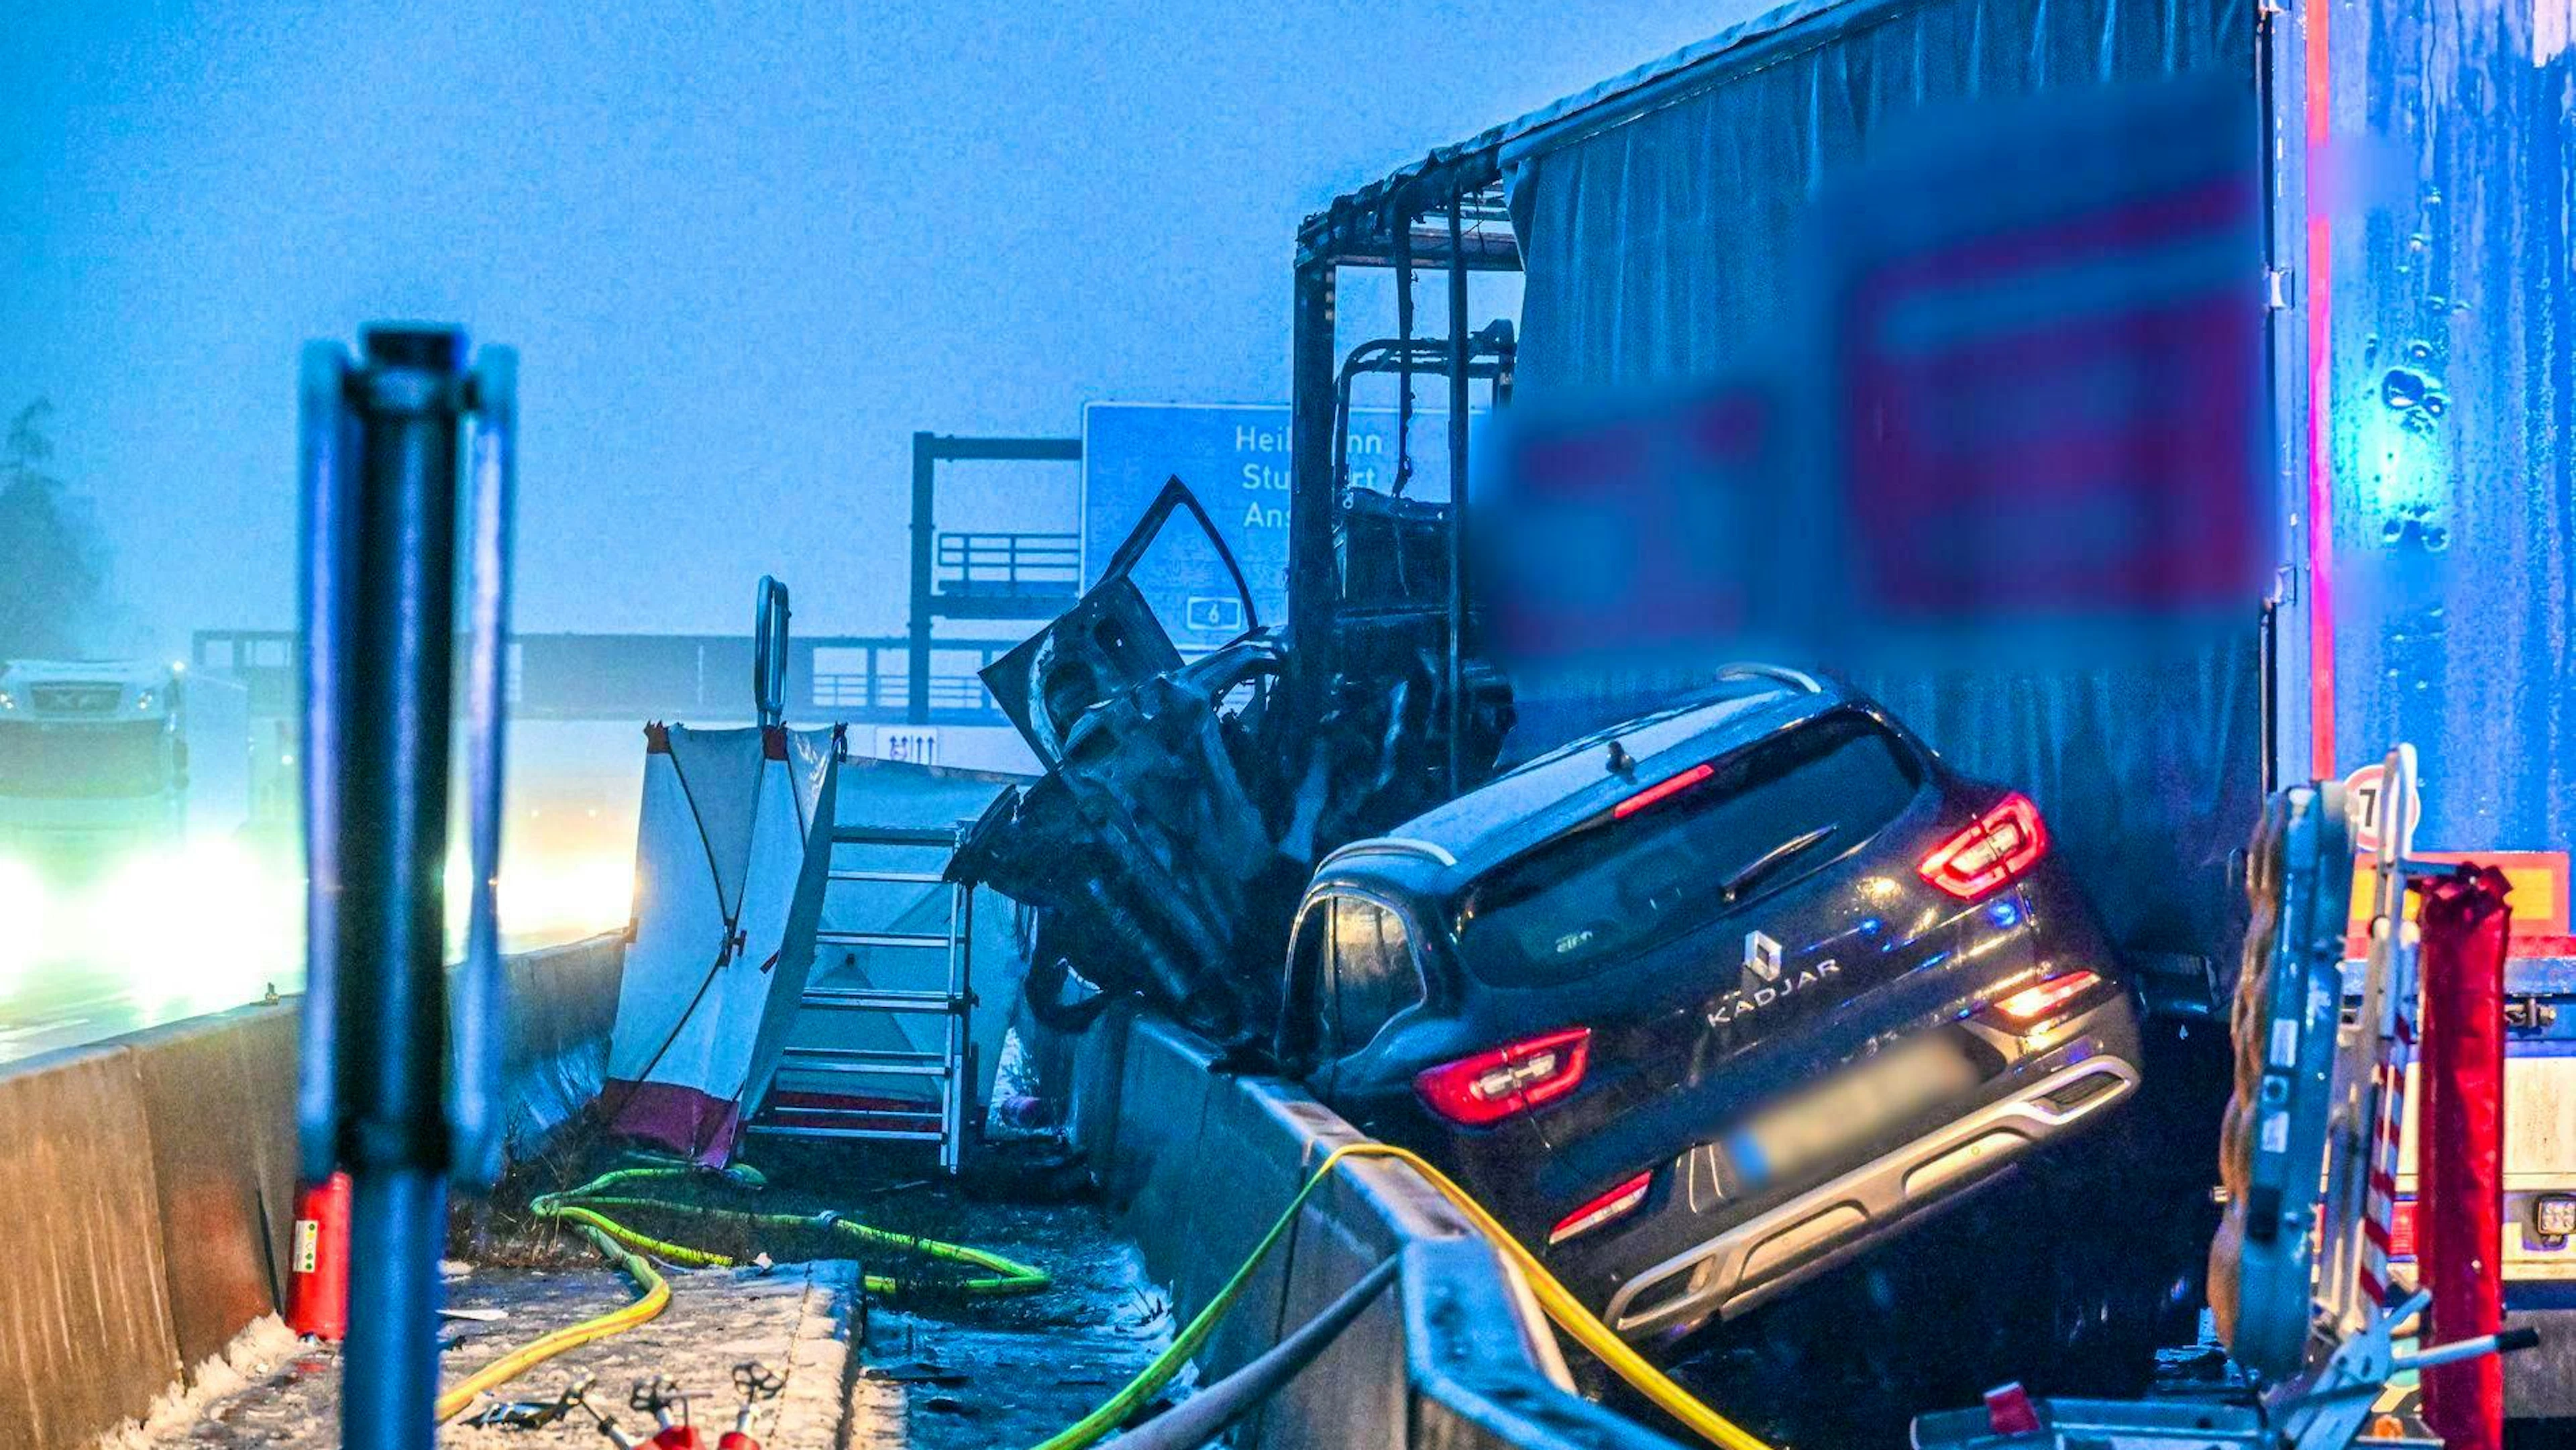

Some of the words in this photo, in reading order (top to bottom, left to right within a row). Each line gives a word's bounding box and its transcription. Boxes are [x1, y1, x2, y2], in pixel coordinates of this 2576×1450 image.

[1236, 425, 1382, 454] Heilnn
[1242, 462, 1375, 490] Sturt
[1209, 603, 1220, 623] 6
[2359, 789, 2377, 827] 7
[1706, 959, 1840, 1027] KADJAR
